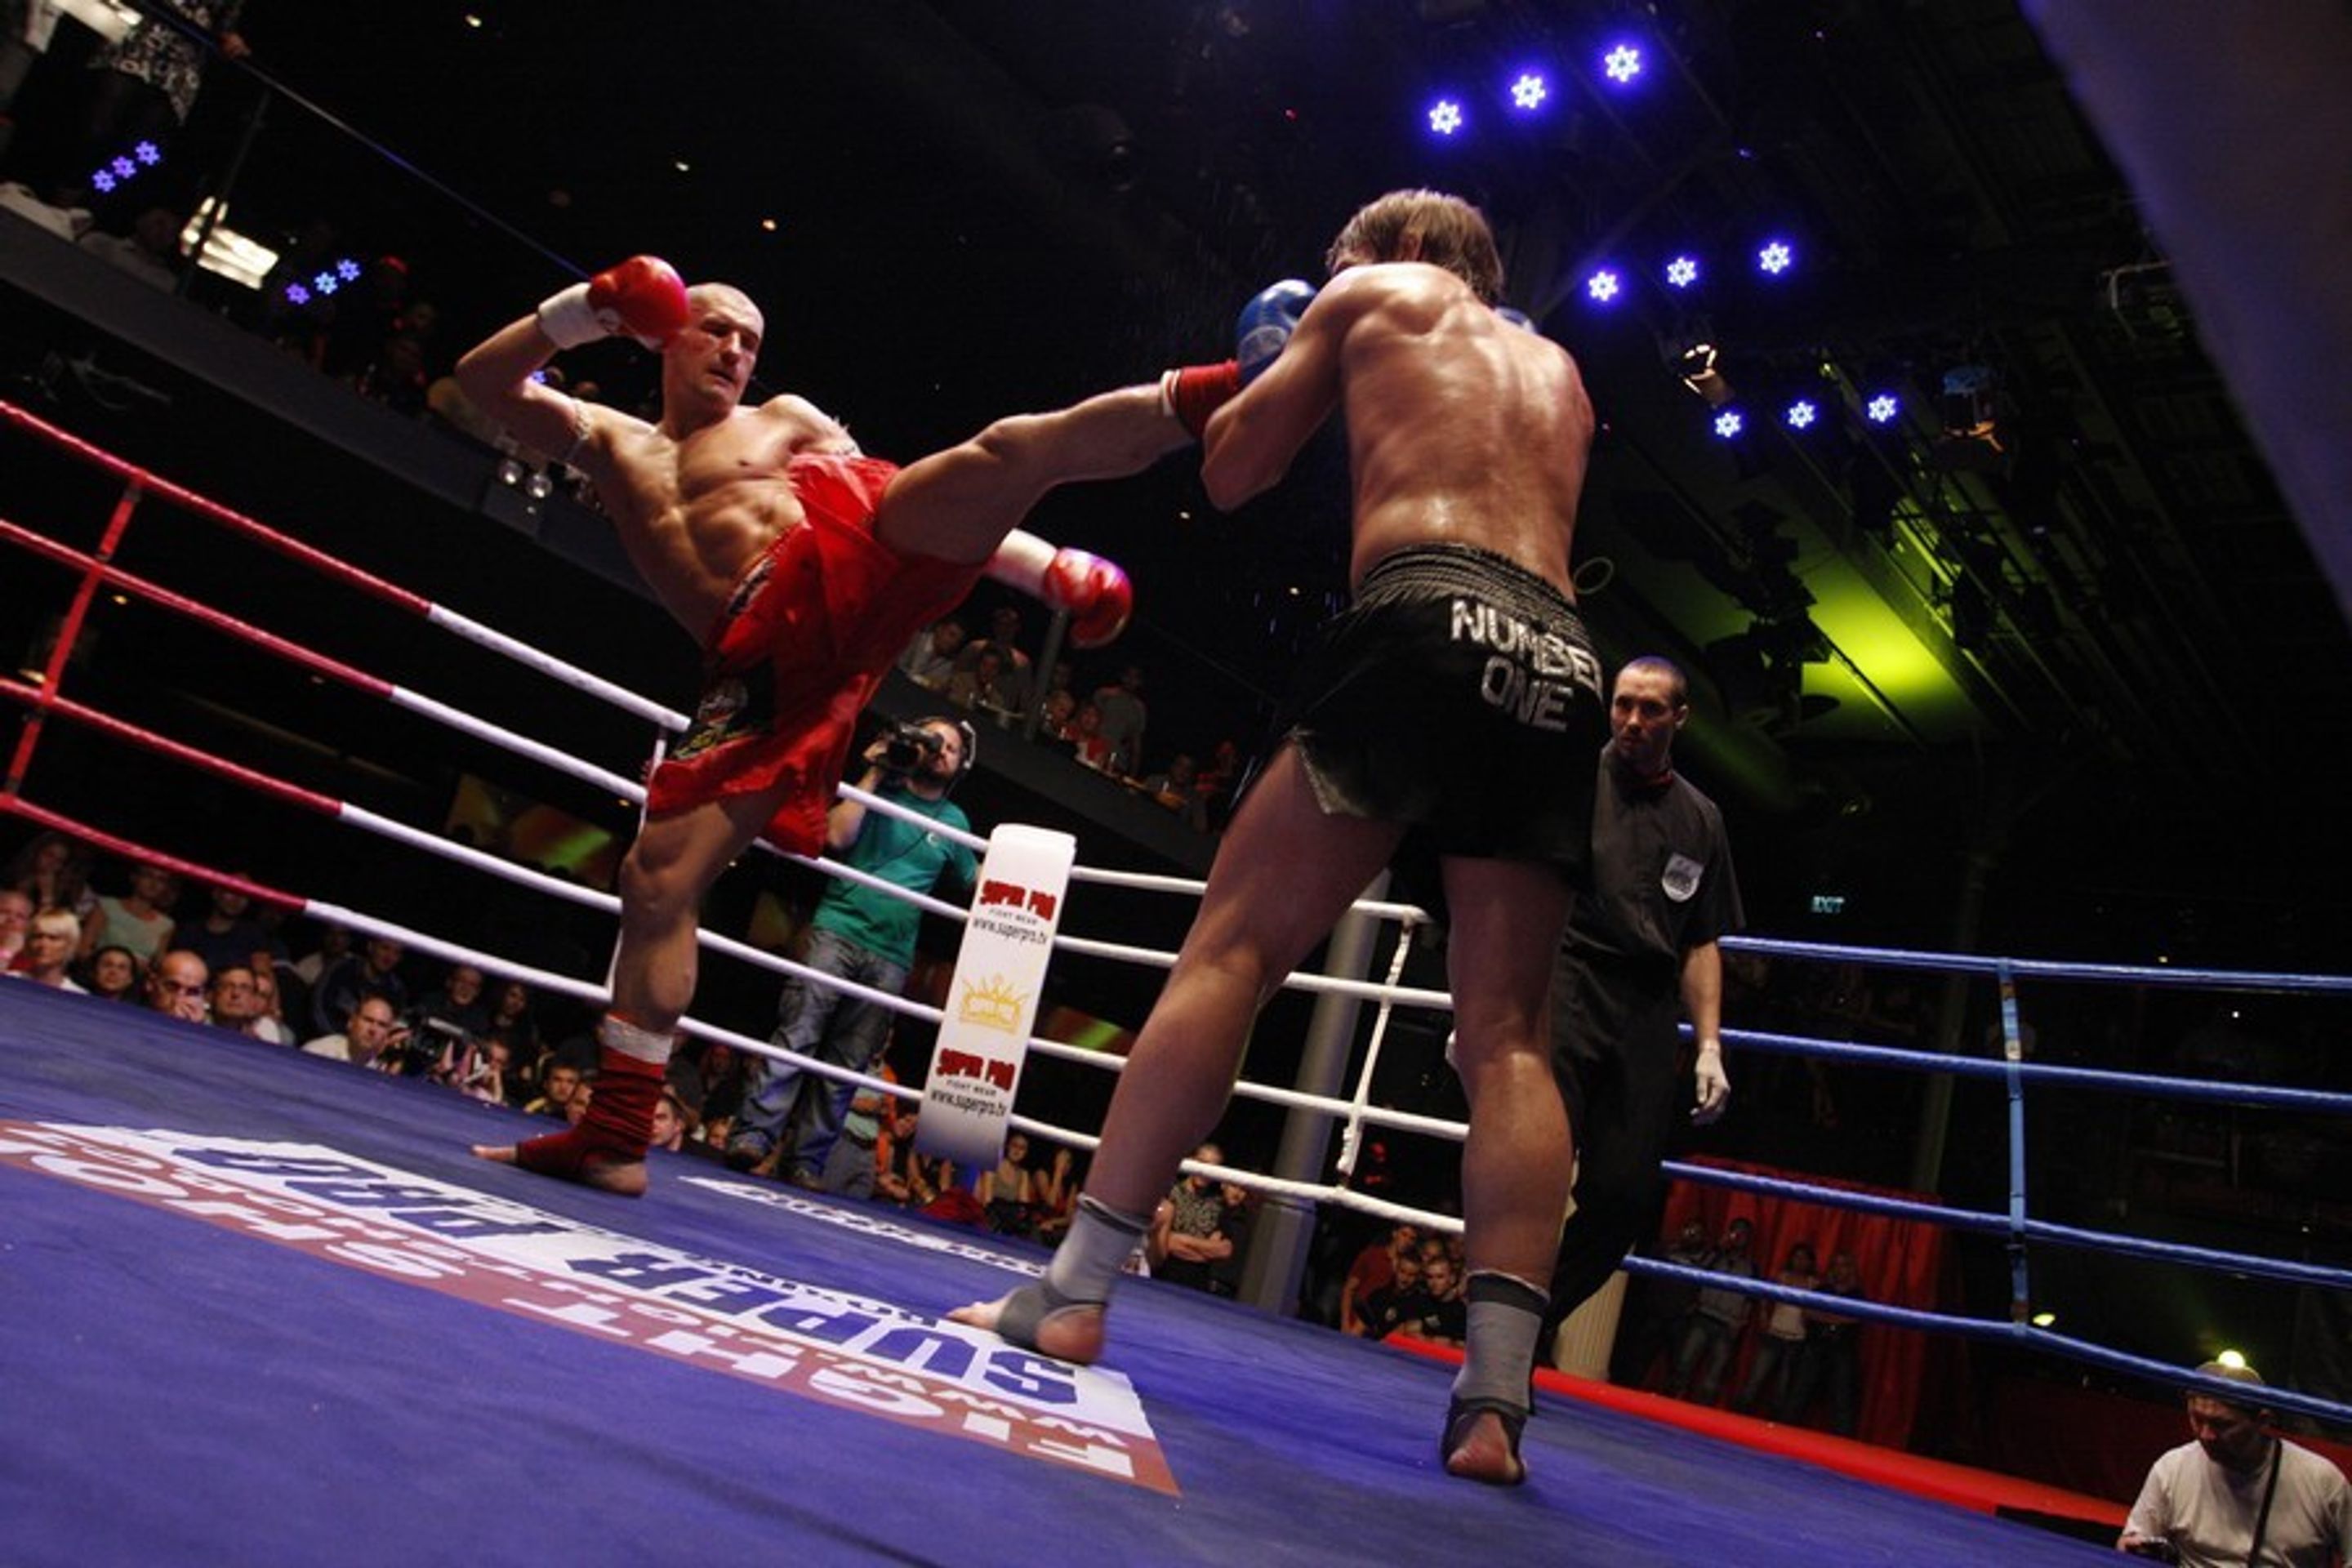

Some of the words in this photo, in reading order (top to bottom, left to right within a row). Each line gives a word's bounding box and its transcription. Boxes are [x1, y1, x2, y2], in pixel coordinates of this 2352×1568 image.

[1451, 599, 1603, 702] NUMBE
[1481, 655, 1574, 733] ONE
[979, 879, 1026, 909] SUPER
[1027, 889, 1057, 922] PRO
[1811, 895, 1845, 913] EXIT
[936, 1048, 983, 1078] SUPER
[985, 1059, 1015, 1092] PRO
[172, 1147, 572, 1239] PRO
[565, 1253, 1078, 1405] SUPER
[502, 1298, 1135, 1478] FIGHT
